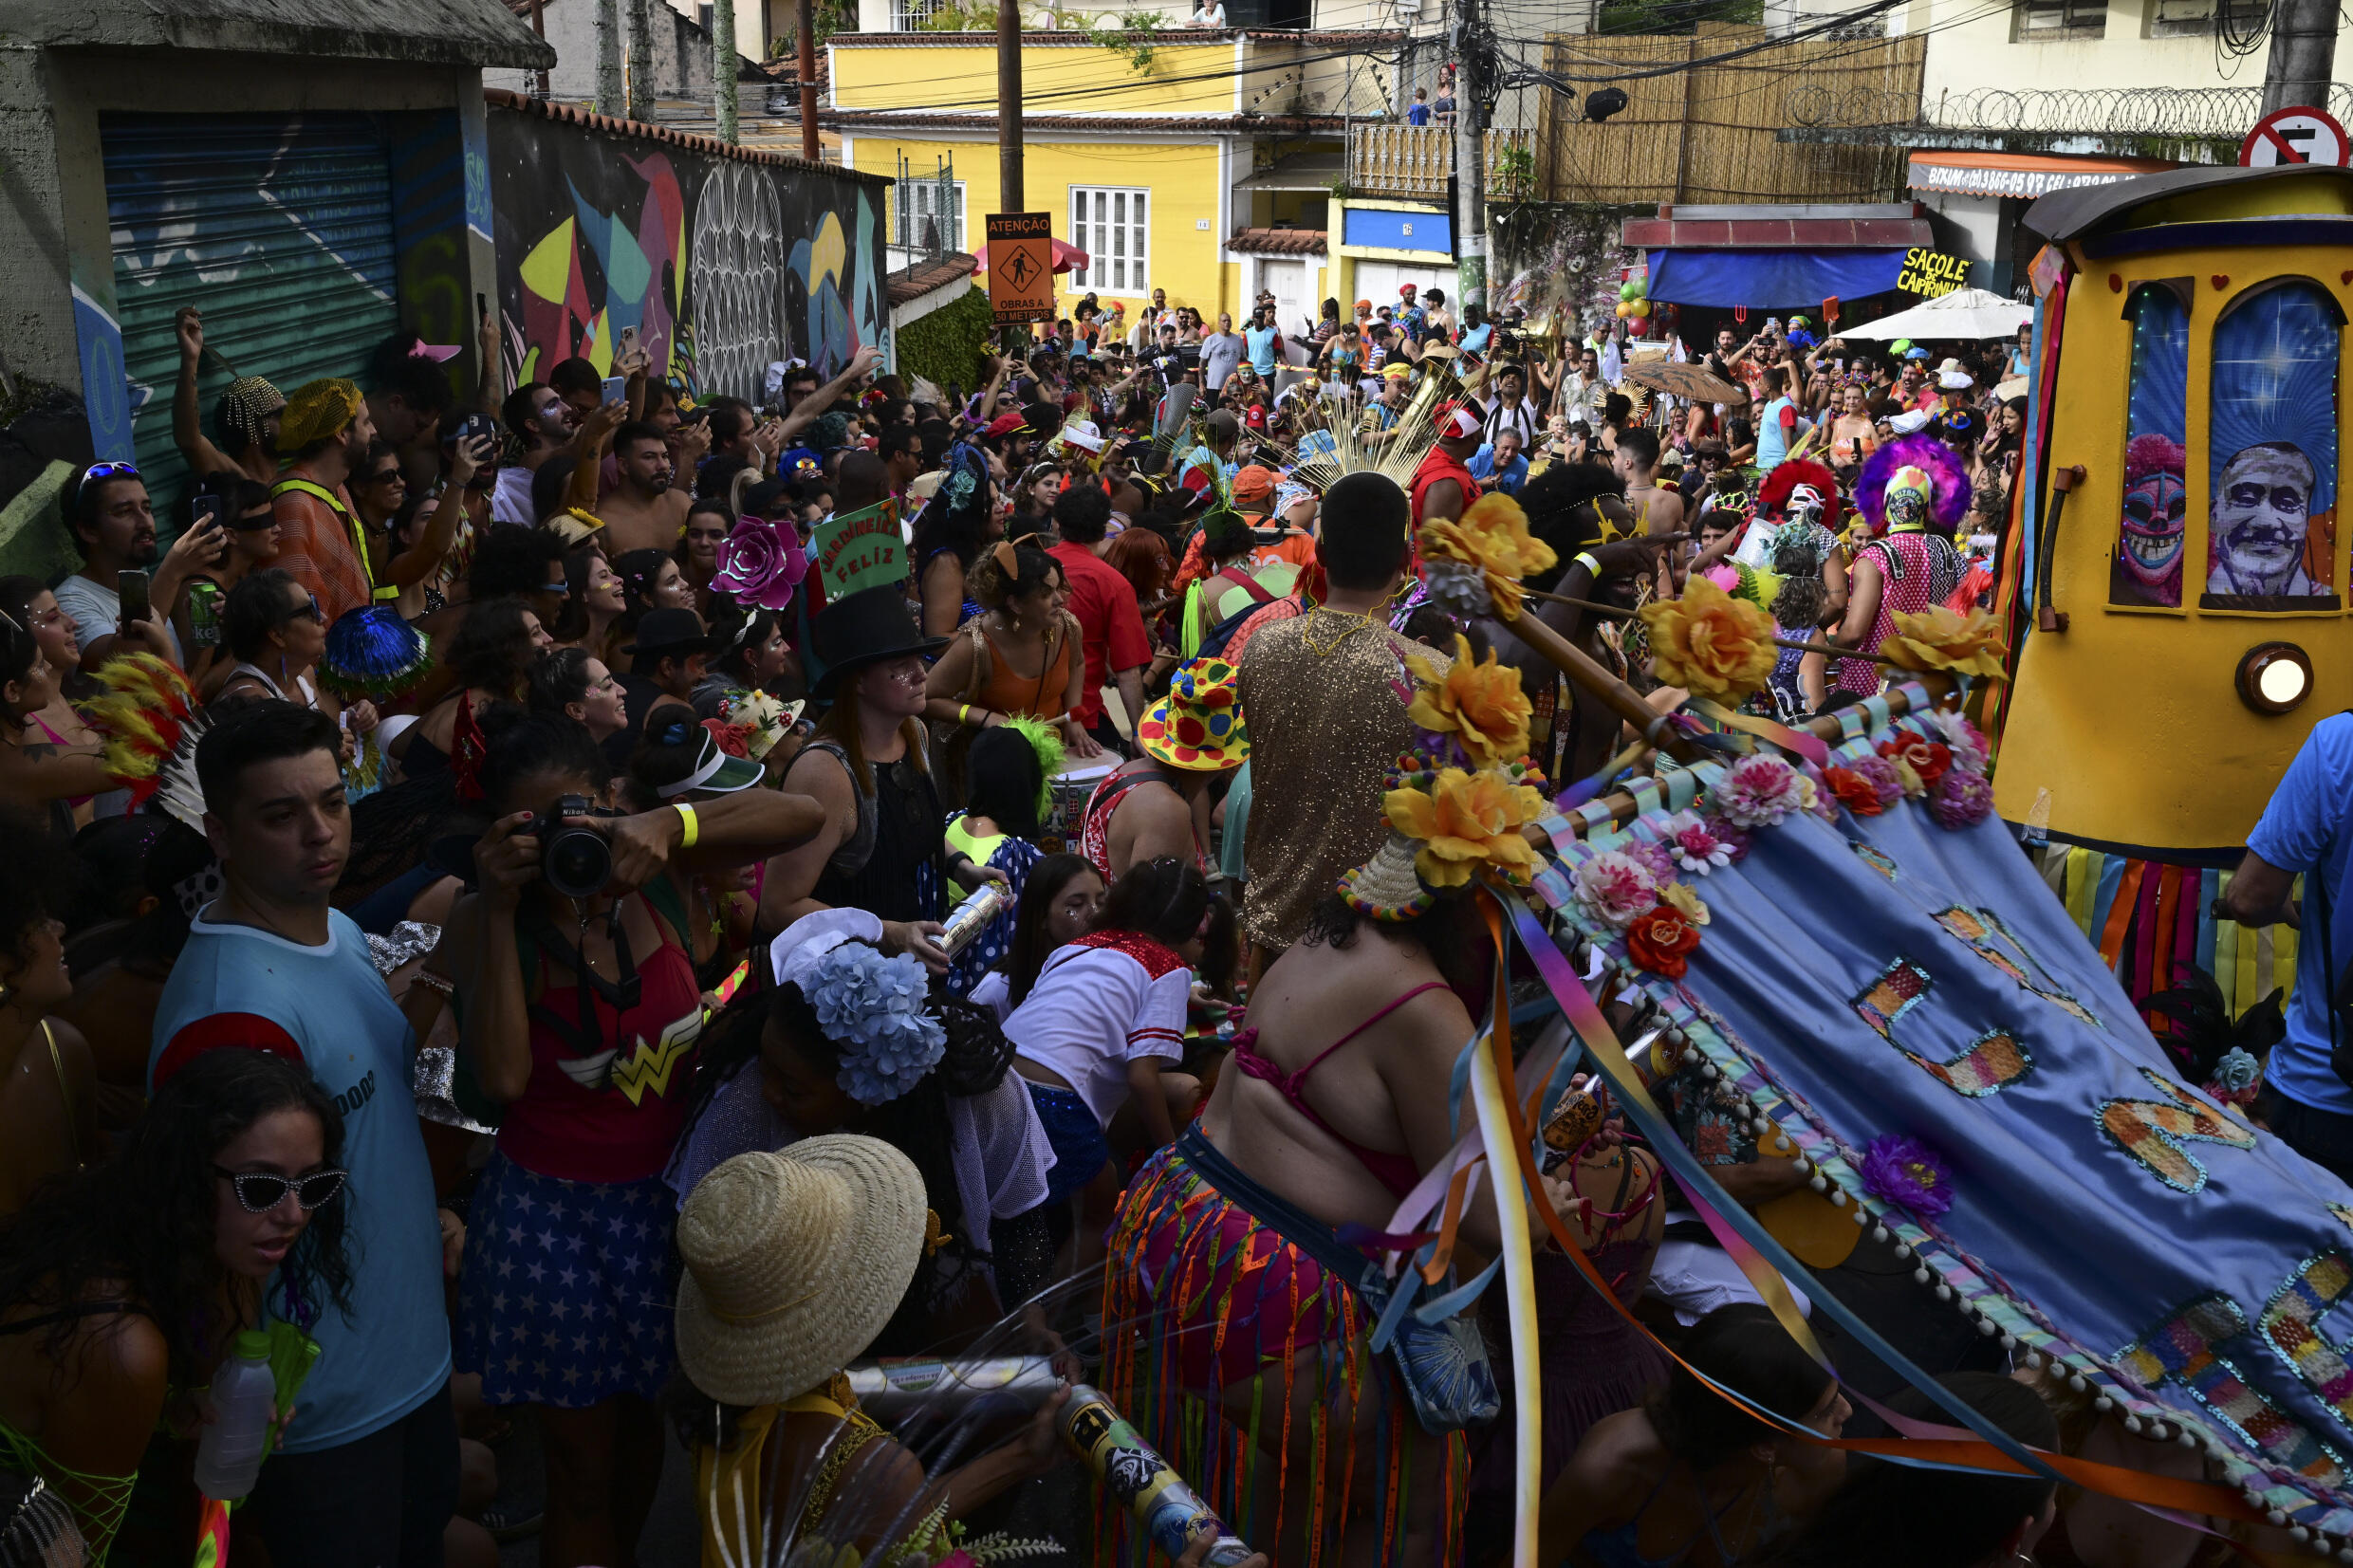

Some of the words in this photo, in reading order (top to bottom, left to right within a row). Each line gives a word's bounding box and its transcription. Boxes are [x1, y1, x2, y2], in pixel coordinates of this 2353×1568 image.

[989, 217, 1049, 233] ATENÇÃO
[1000, 299, 1035, 309] OBRAS
[1037, 299, 1044, 307] A
[995, 312, 1007, 322] 50
[1009, 310, 1050, 321] METROS
